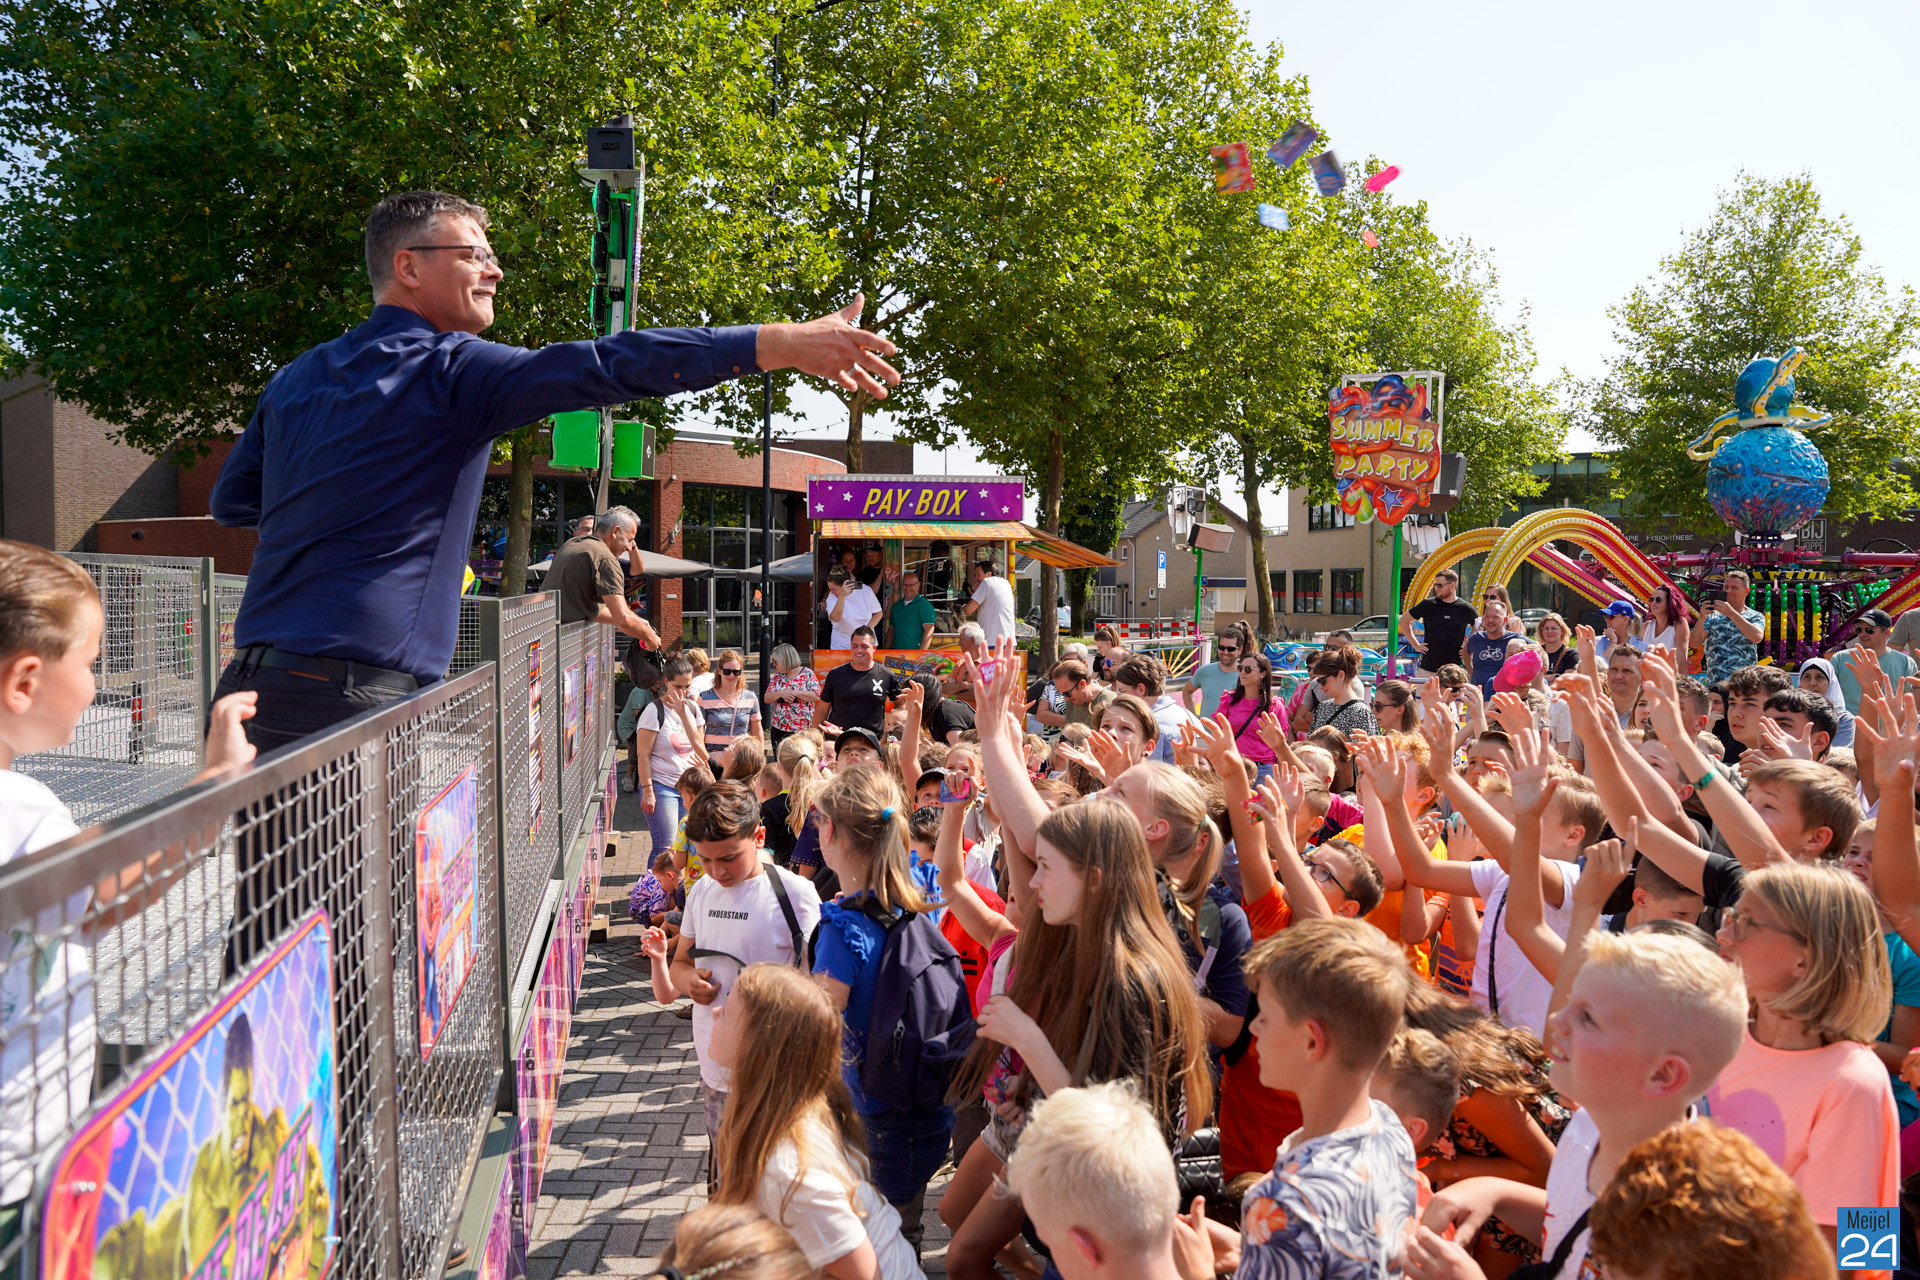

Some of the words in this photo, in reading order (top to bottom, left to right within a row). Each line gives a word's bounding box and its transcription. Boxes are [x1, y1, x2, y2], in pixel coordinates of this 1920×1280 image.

[1332, 417, 1434, 452] SUMMER
[1337, 454, 1428, 481] PARTY
[862, 488, 912, 515] PAY
[914, 489, 968, 516] BOX
[1801, 520, 1824, 539] BIJ
[886, 658, 934, 672] SUMMER
[708, 909, 749, 920] UNDERSTAND
